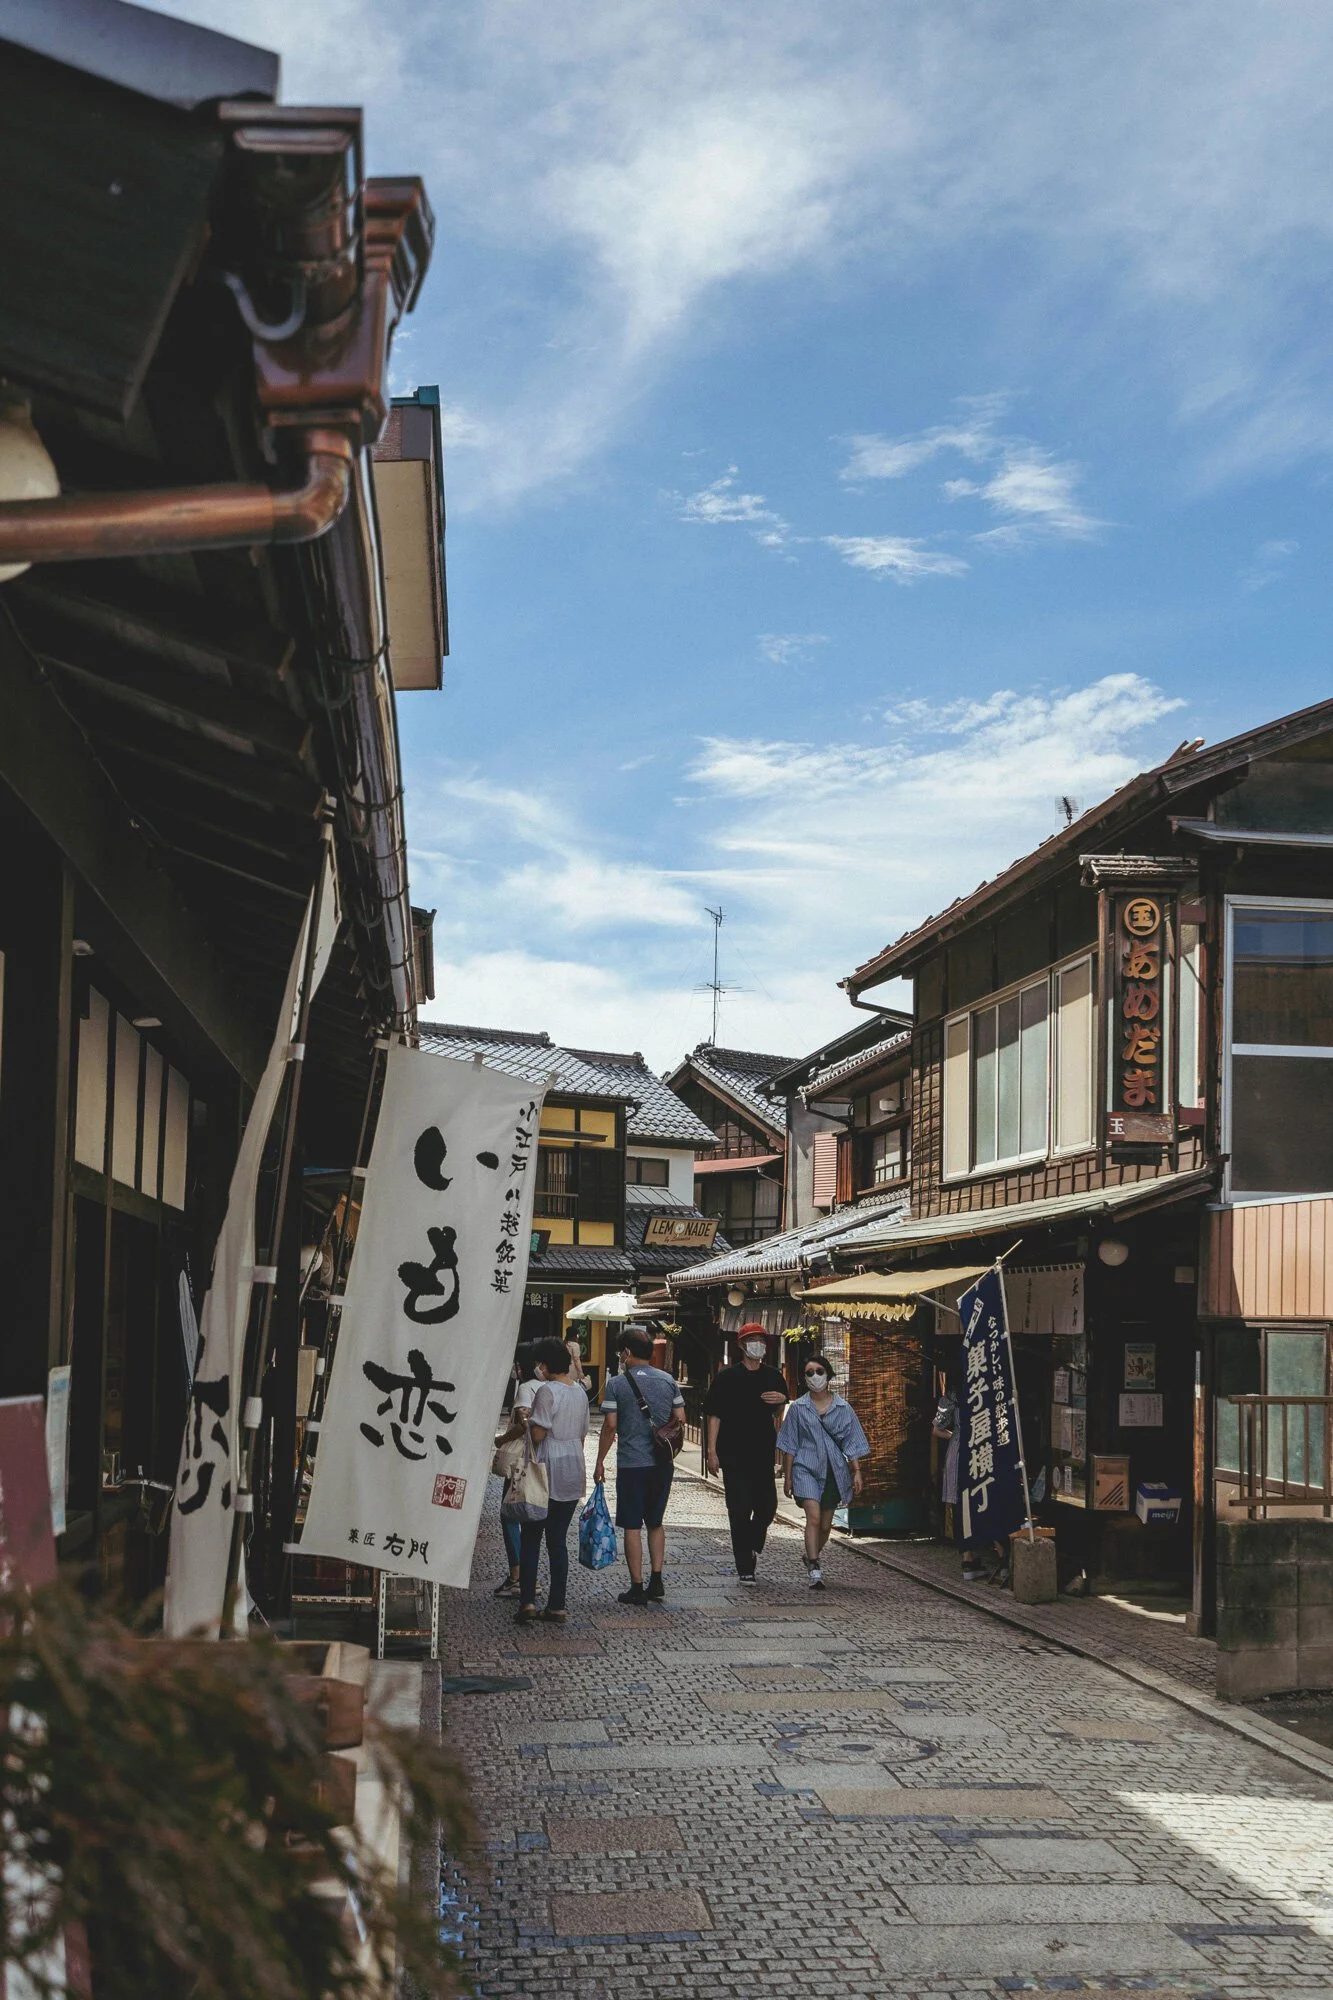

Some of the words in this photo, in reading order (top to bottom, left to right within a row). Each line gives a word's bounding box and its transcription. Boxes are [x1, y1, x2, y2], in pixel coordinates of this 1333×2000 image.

[1122, 939, 1161, 1107] あめだま
[652, 1220, 712, 1237] LEMONADE
[360, 1126, 499, 1461] いも恋
[966, 1339, 995, 1513] 菓子屋横丁
[348, 1528, 375, 1546] 菓匠
[383, 1533, 429, 1564] 右門
[1152, 1510, 1174, 1520] meiji
